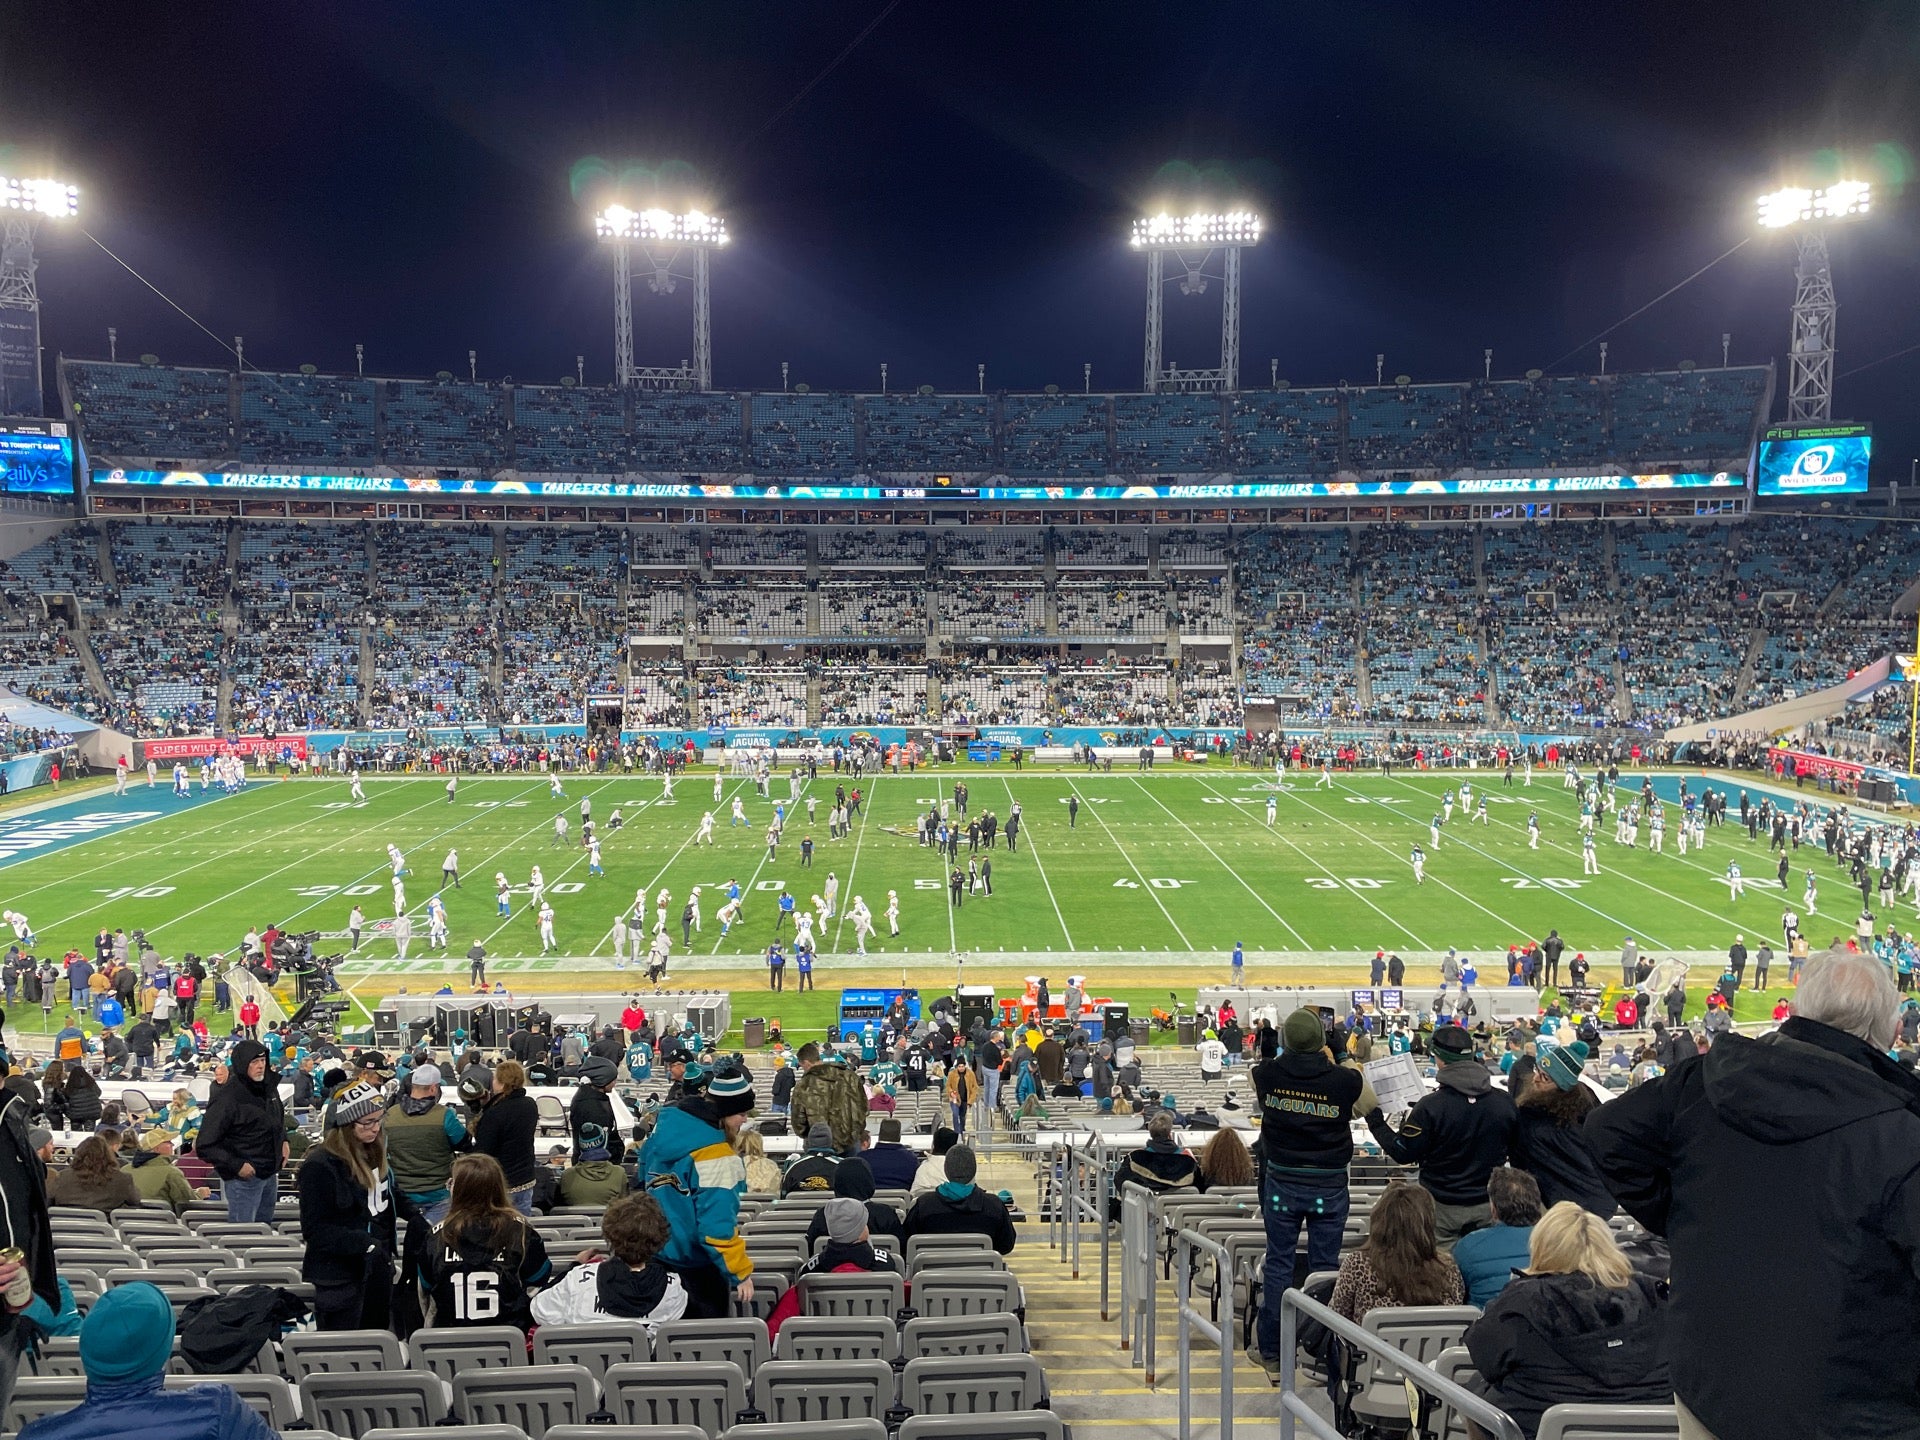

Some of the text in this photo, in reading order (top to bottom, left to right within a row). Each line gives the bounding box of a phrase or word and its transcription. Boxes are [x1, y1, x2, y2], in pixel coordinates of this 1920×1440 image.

[10, 442, 42, 450] TONIGHT'S
[223, 474, 393, 491] CHARGERS VS JAGUARS
[1458, 476, 1622, 493] CHARGERS VS JAGUARS
[542, 482, 691, 497] CHARGERS VS JAGUARS
[1169, 484, 1314, 498] CHARGERS VS JAGUARS
[1718, 727, 1770, 741] TIAA Bank
[153, 740, 300, 755] SUPER WILD CARD WEEKEND
[730, 738, 771, 748] JAGUARS
[1112, 878, 1182, 890] 40
[1304, 878, 1384, 889] 30
[1501, 877, 1584, 889] 20
[105, 886, 177, 898] 10
[297, 885, 384, 896] 20
[801, 921, 811, 929] 43
[684, 1040, 695, 1050] 16
[865, 1038, 874, 1048] 13
[1393, 1040, 1403, 1052] 13
[631, 1053, 647, 1067] 28
[1209, 1049, 1219, 1060] 16
[909, 1056, 924, 1070] 41
[877, 1071, 895, 1086] 28
[1273, 1088, 1329, 1101] JACKSONVILLE
[1264, 1093, 1341, 1119] JAGUARS
[873, 1248, 889, 1263] 16
[450, 1271, 500, 1321] 16
